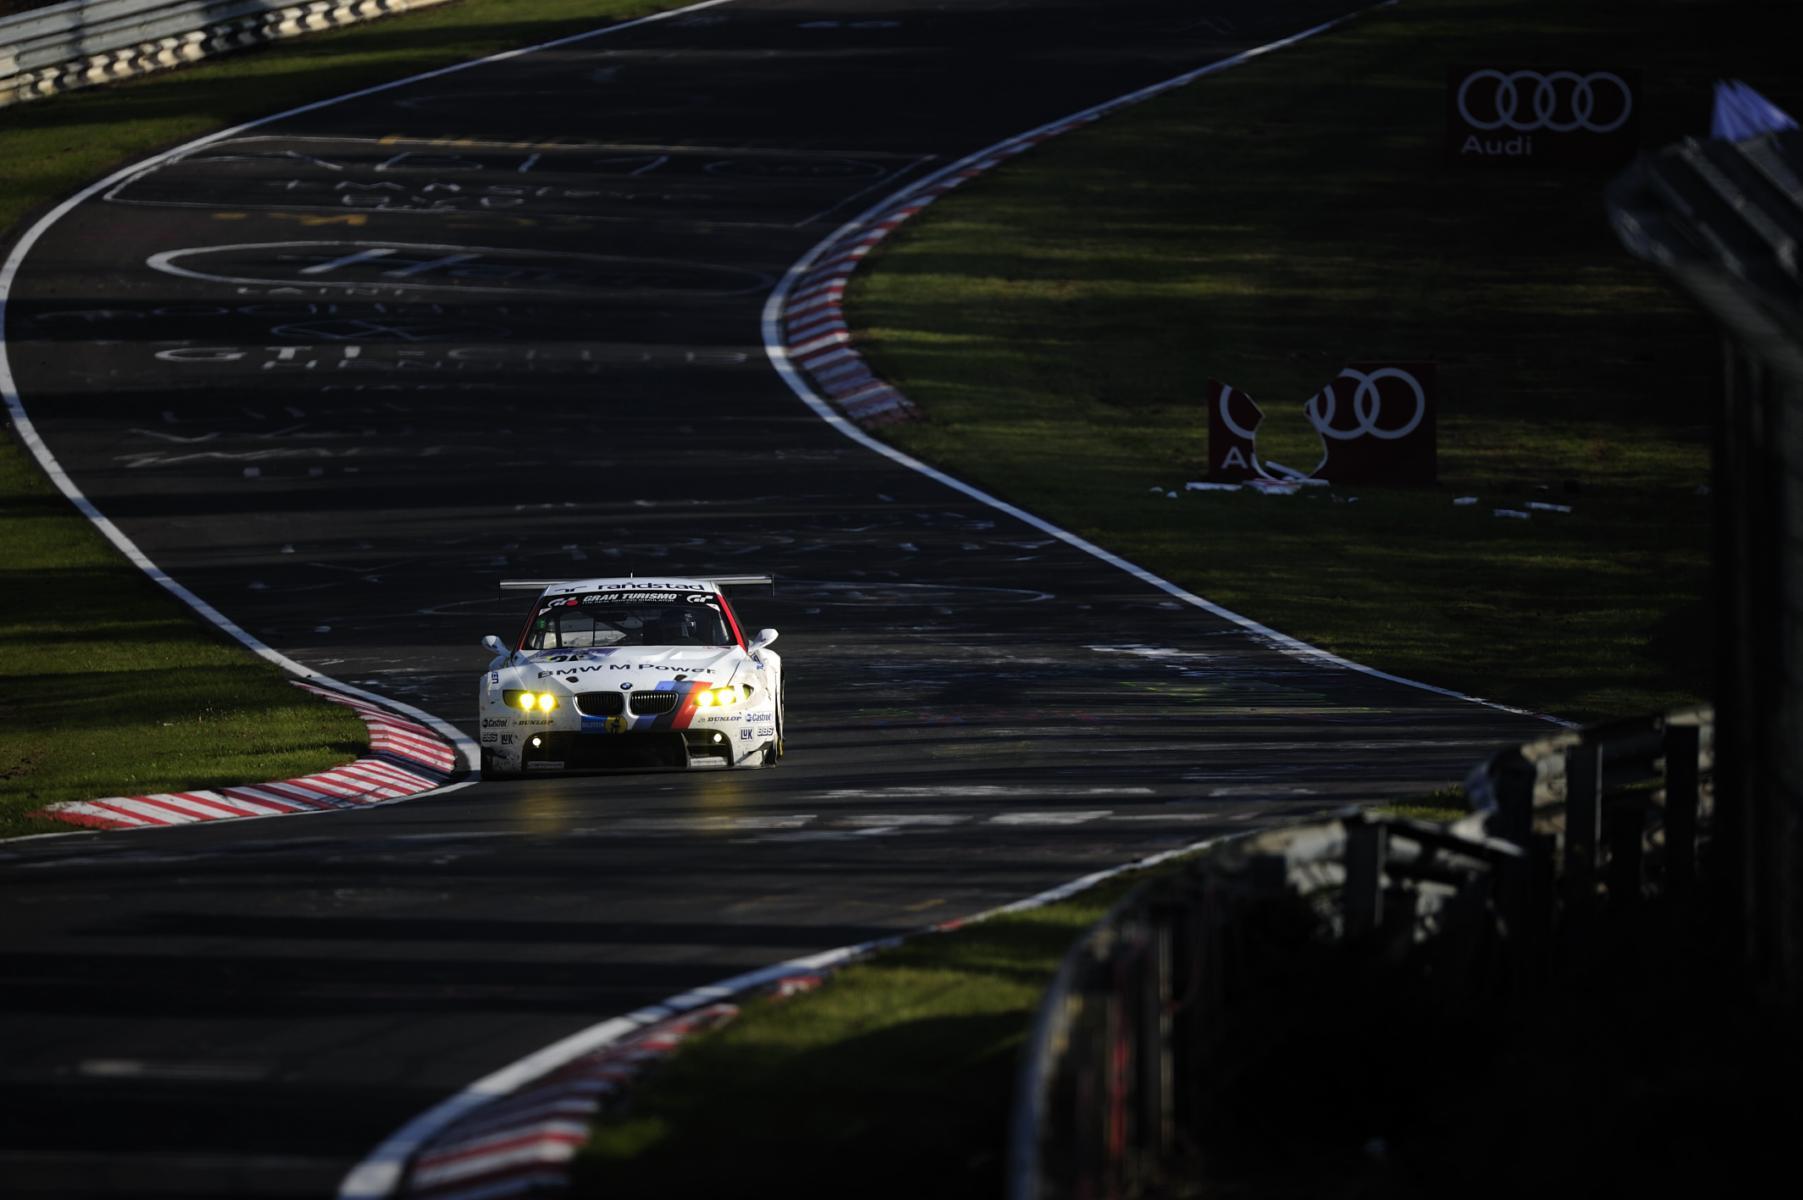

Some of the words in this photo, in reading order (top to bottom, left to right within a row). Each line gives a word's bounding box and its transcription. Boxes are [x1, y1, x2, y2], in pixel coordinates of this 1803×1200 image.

[1460, 134, 1533, 155] Audi
[598, 582, 705, 591] randstad
[583, 594, 618, 602] GRAN
[537, 665, 602, 679] BMW
[638, 663, 716, 674] Power
